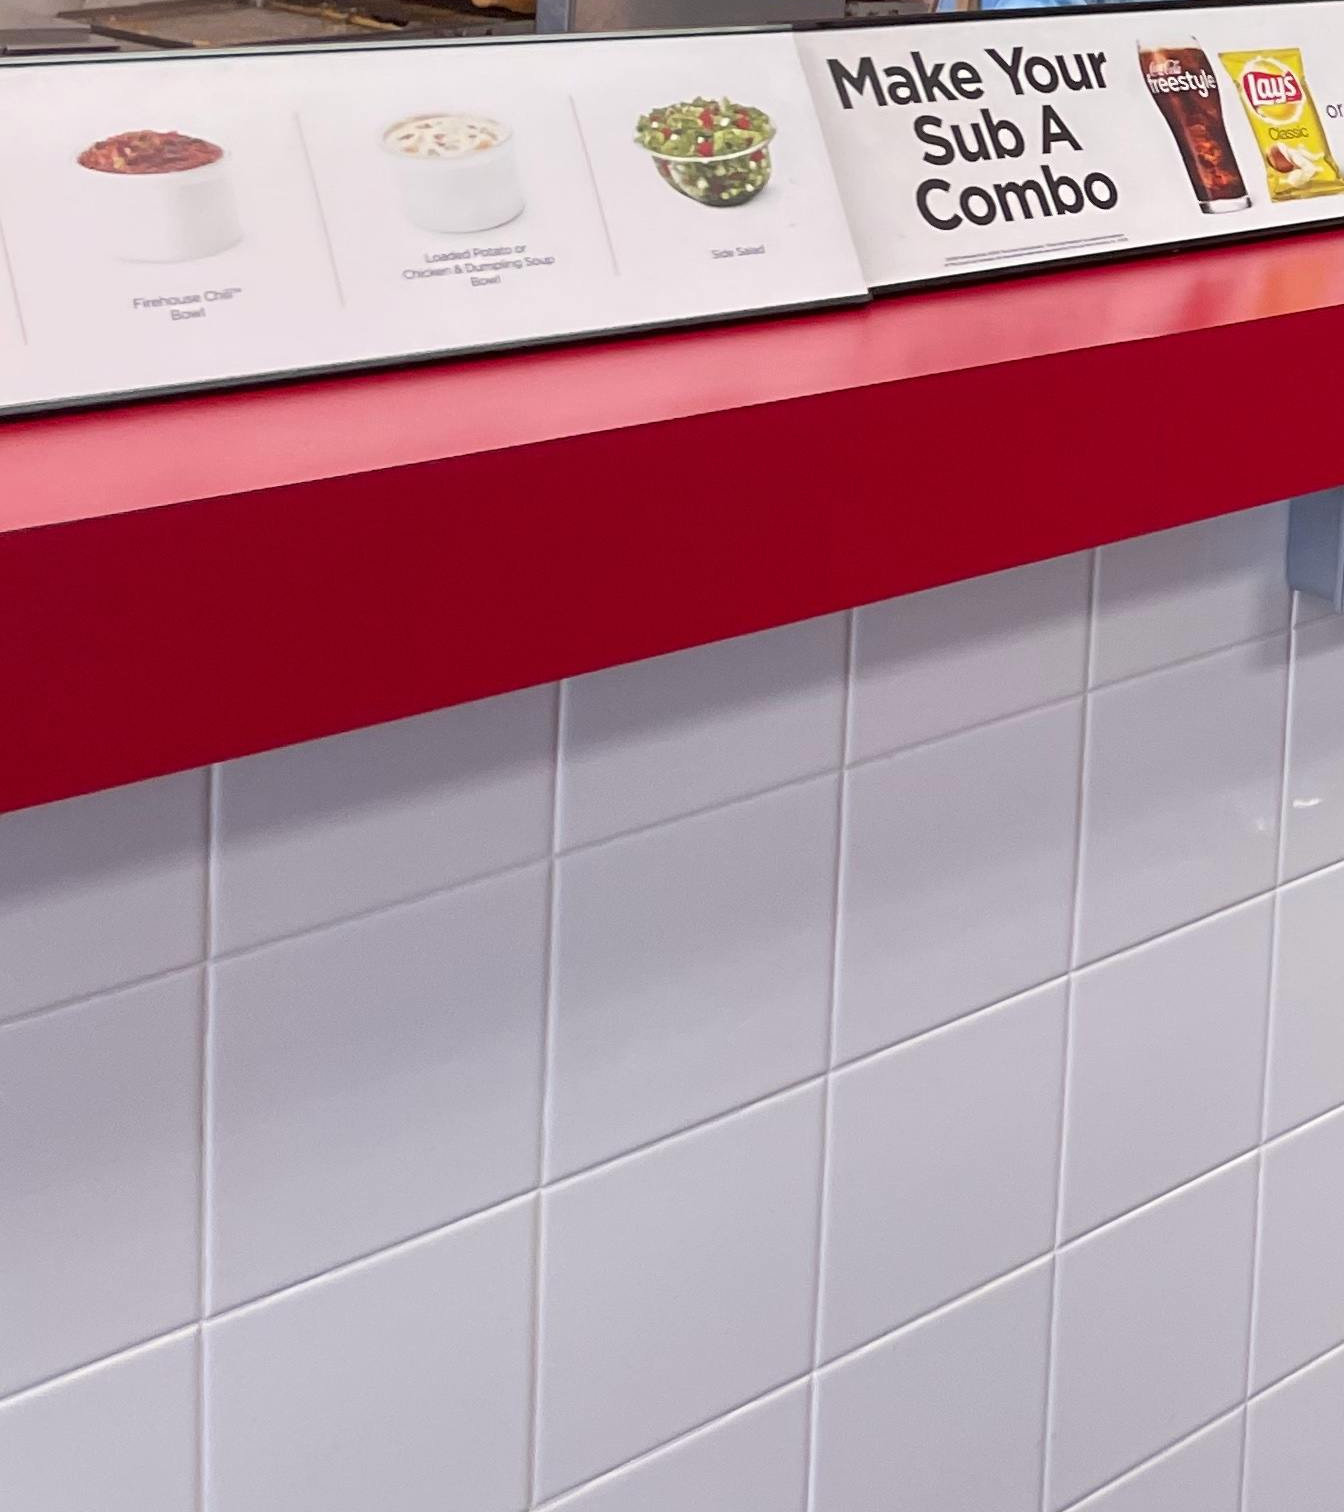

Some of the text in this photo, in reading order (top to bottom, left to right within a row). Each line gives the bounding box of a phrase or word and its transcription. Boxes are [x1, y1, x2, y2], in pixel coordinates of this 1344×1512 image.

[826, 46, 1108, 110] Make Your
[1146, 68, 1217, 98] freestyle
[1250, 71, 1297, 106] Lay's
[1326, 102, 1344, 119] or
[913, 104, 1084, 166] Sub A
[1268, 126, 1309, 141] Classic
[916, 164, 1119, 231] Combo
